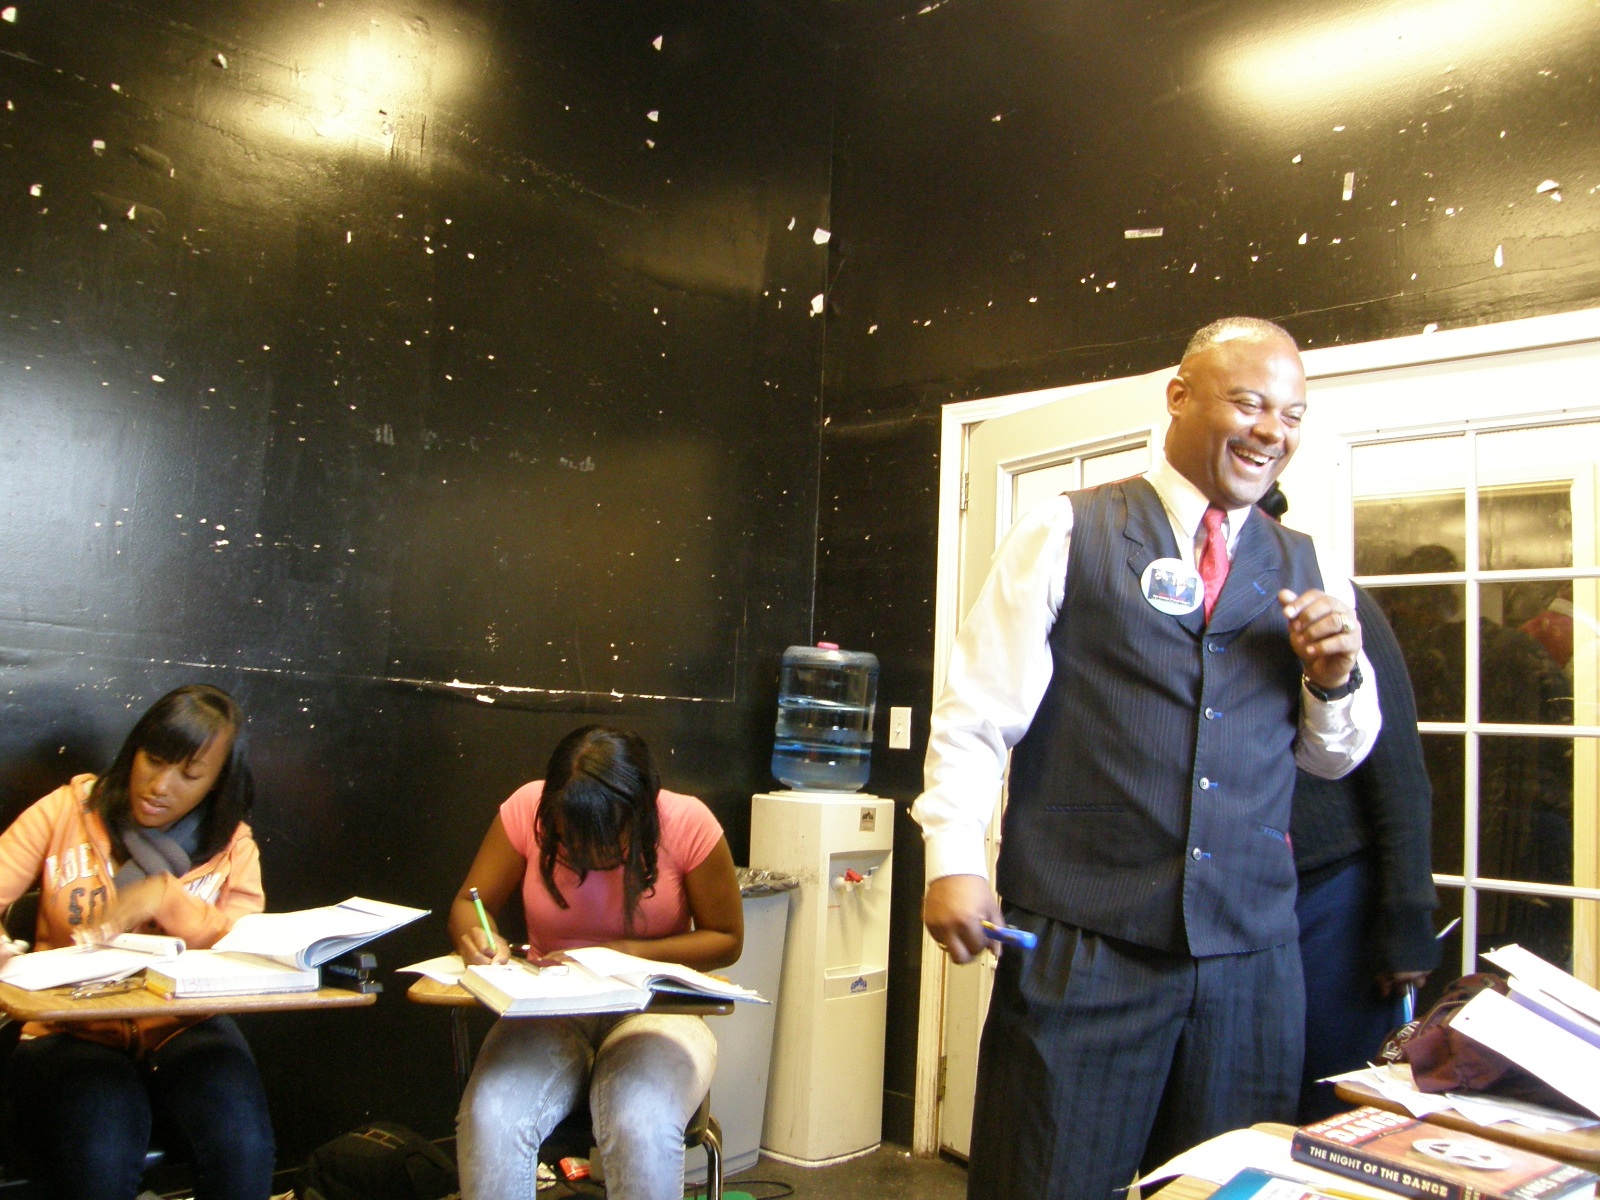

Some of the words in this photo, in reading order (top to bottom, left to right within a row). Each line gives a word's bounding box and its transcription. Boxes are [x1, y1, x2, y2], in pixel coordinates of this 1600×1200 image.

[1324, 1111, 1411, 1143] DANCE
[1309, 1145, 1328, 1160] THE
[1329, 1152, 1362, 1170] NIGHT
[1363, 1163, 1379, 1175] OF
[1380, 1167, 1400, 1183] THE
[1402, 1173, 1449, 1198] DANCE
